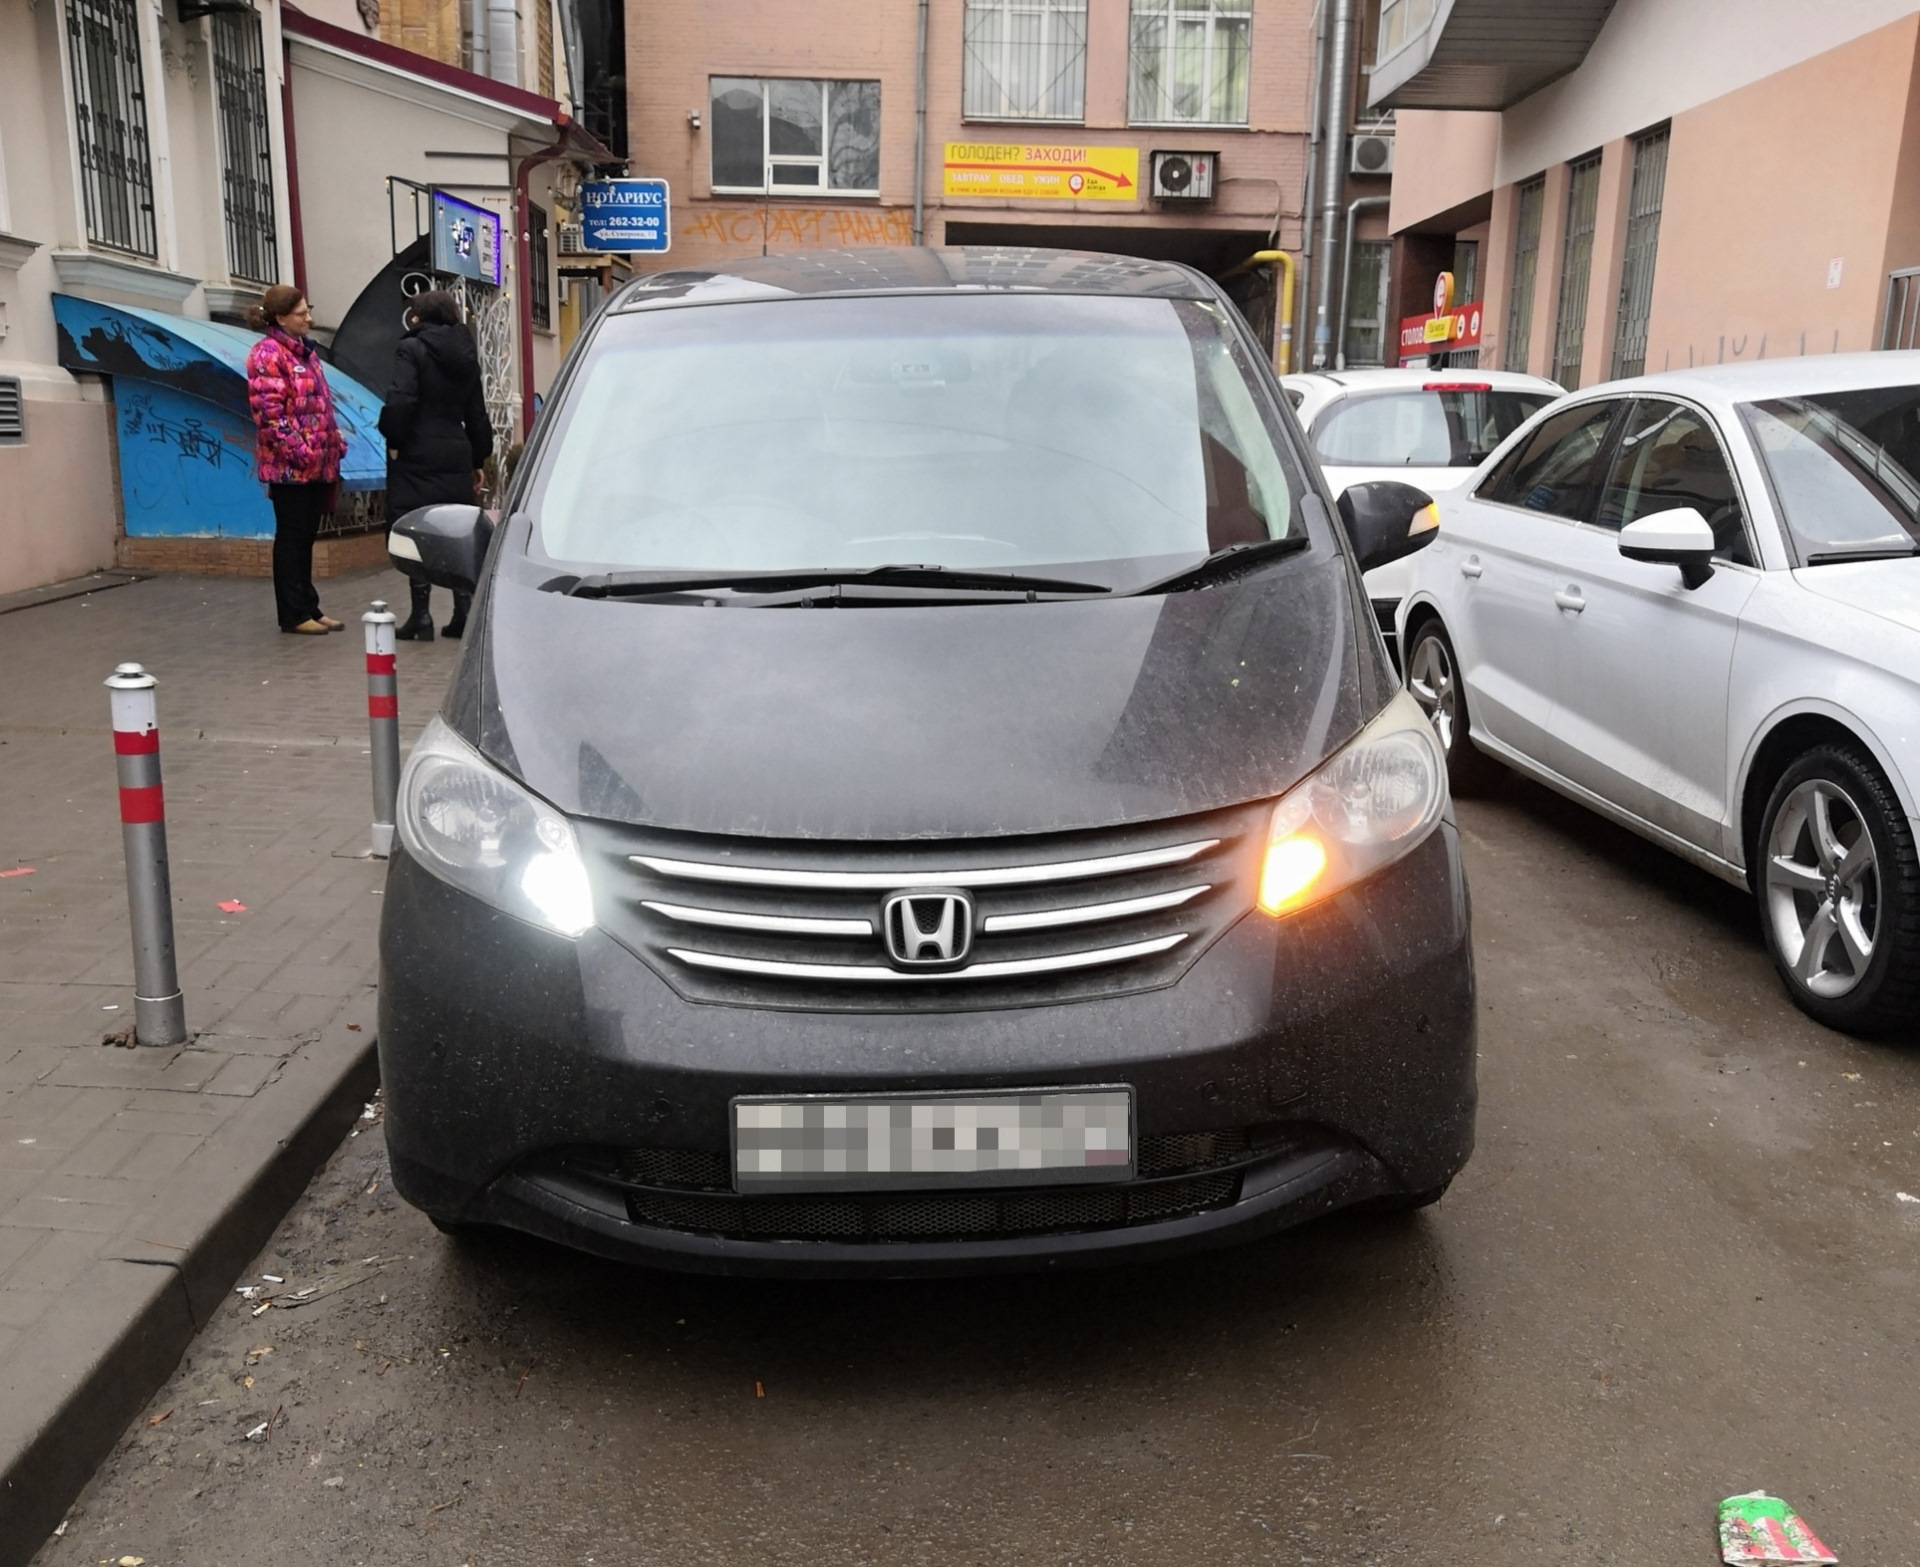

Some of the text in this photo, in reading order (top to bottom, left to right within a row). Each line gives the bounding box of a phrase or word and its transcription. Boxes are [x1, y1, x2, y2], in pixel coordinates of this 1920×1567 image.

[951, 145, 1087, 163] ГОЛОДЕН? ЗАХОДИ!
[951, 172, 1060, 185] ЗАВТРАК ОБЕД УЖИН
[586, 192, 662, 204] НОТАРИУС
[609, 217, 660, 227] 262-32-00
